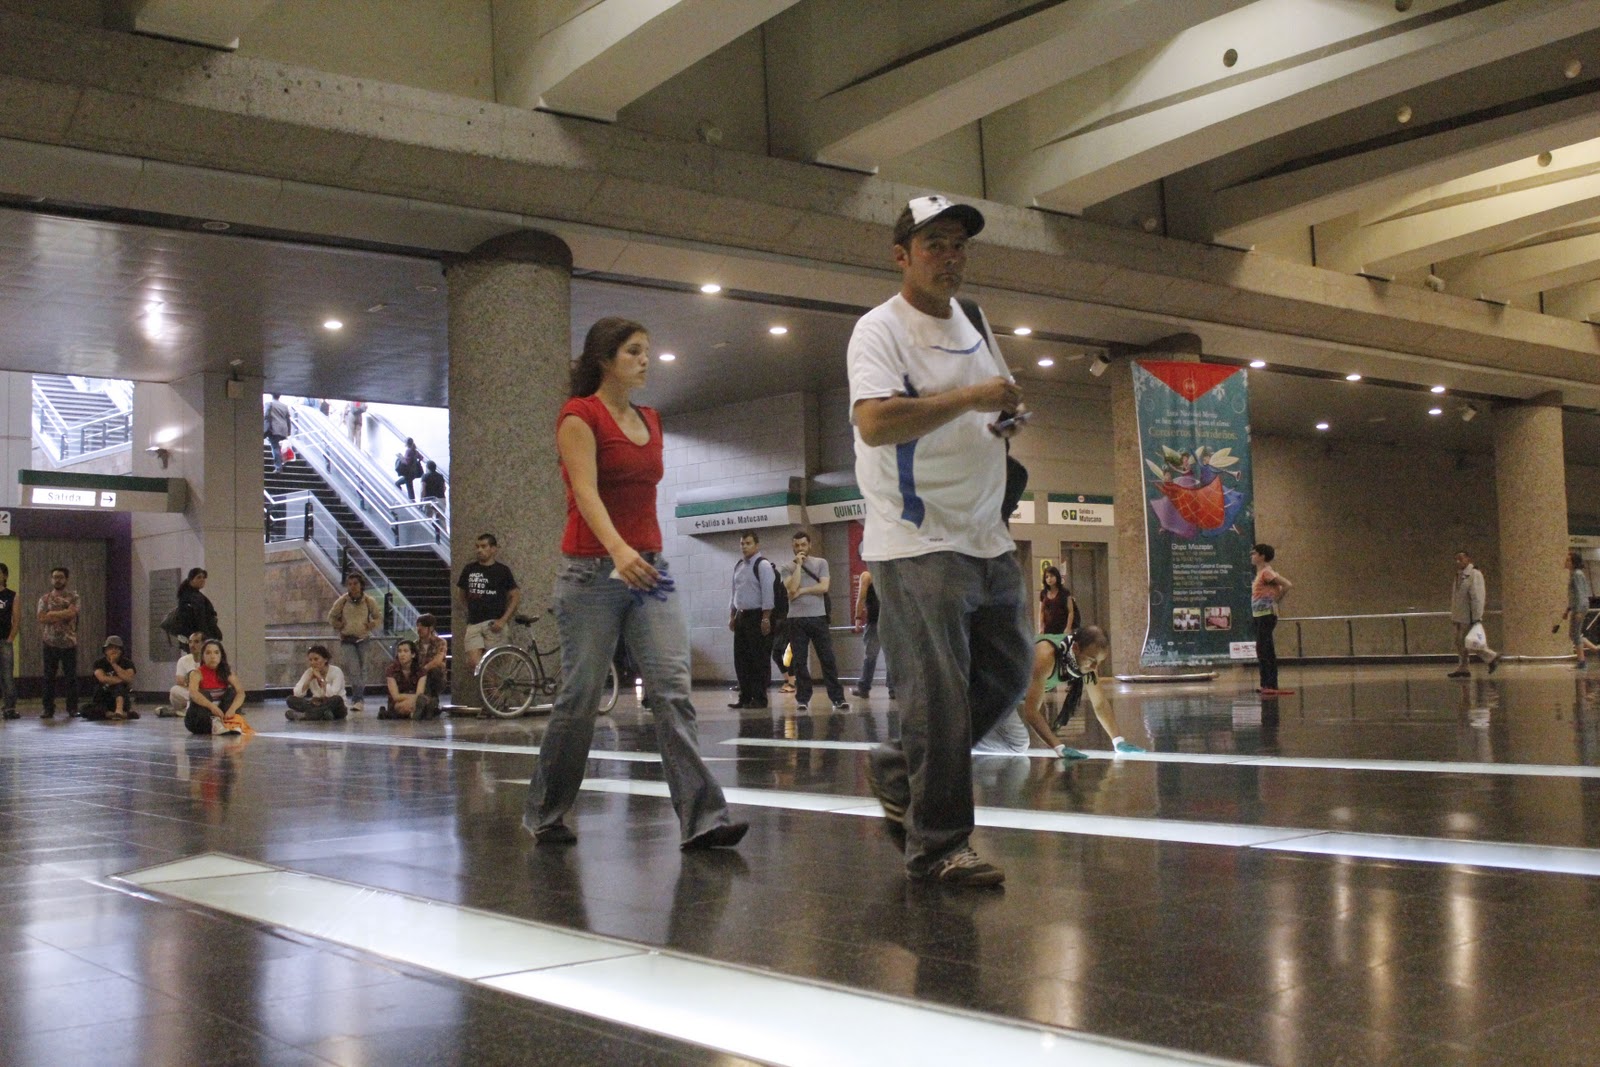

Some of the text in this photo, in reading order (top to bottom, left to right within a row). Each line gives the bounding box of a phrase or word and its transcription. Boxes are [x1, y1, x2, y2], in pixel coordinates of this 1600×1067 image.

[48, 492, 81, 502] Salida
[834, 505, 862, 518] QUINTA
[701, 519, 720, 529] Salida
[727, 517, 736, 525] Av.
[738, 514, 768, 524] Matucana
[1079, 515, 1102, 523] Matucana
